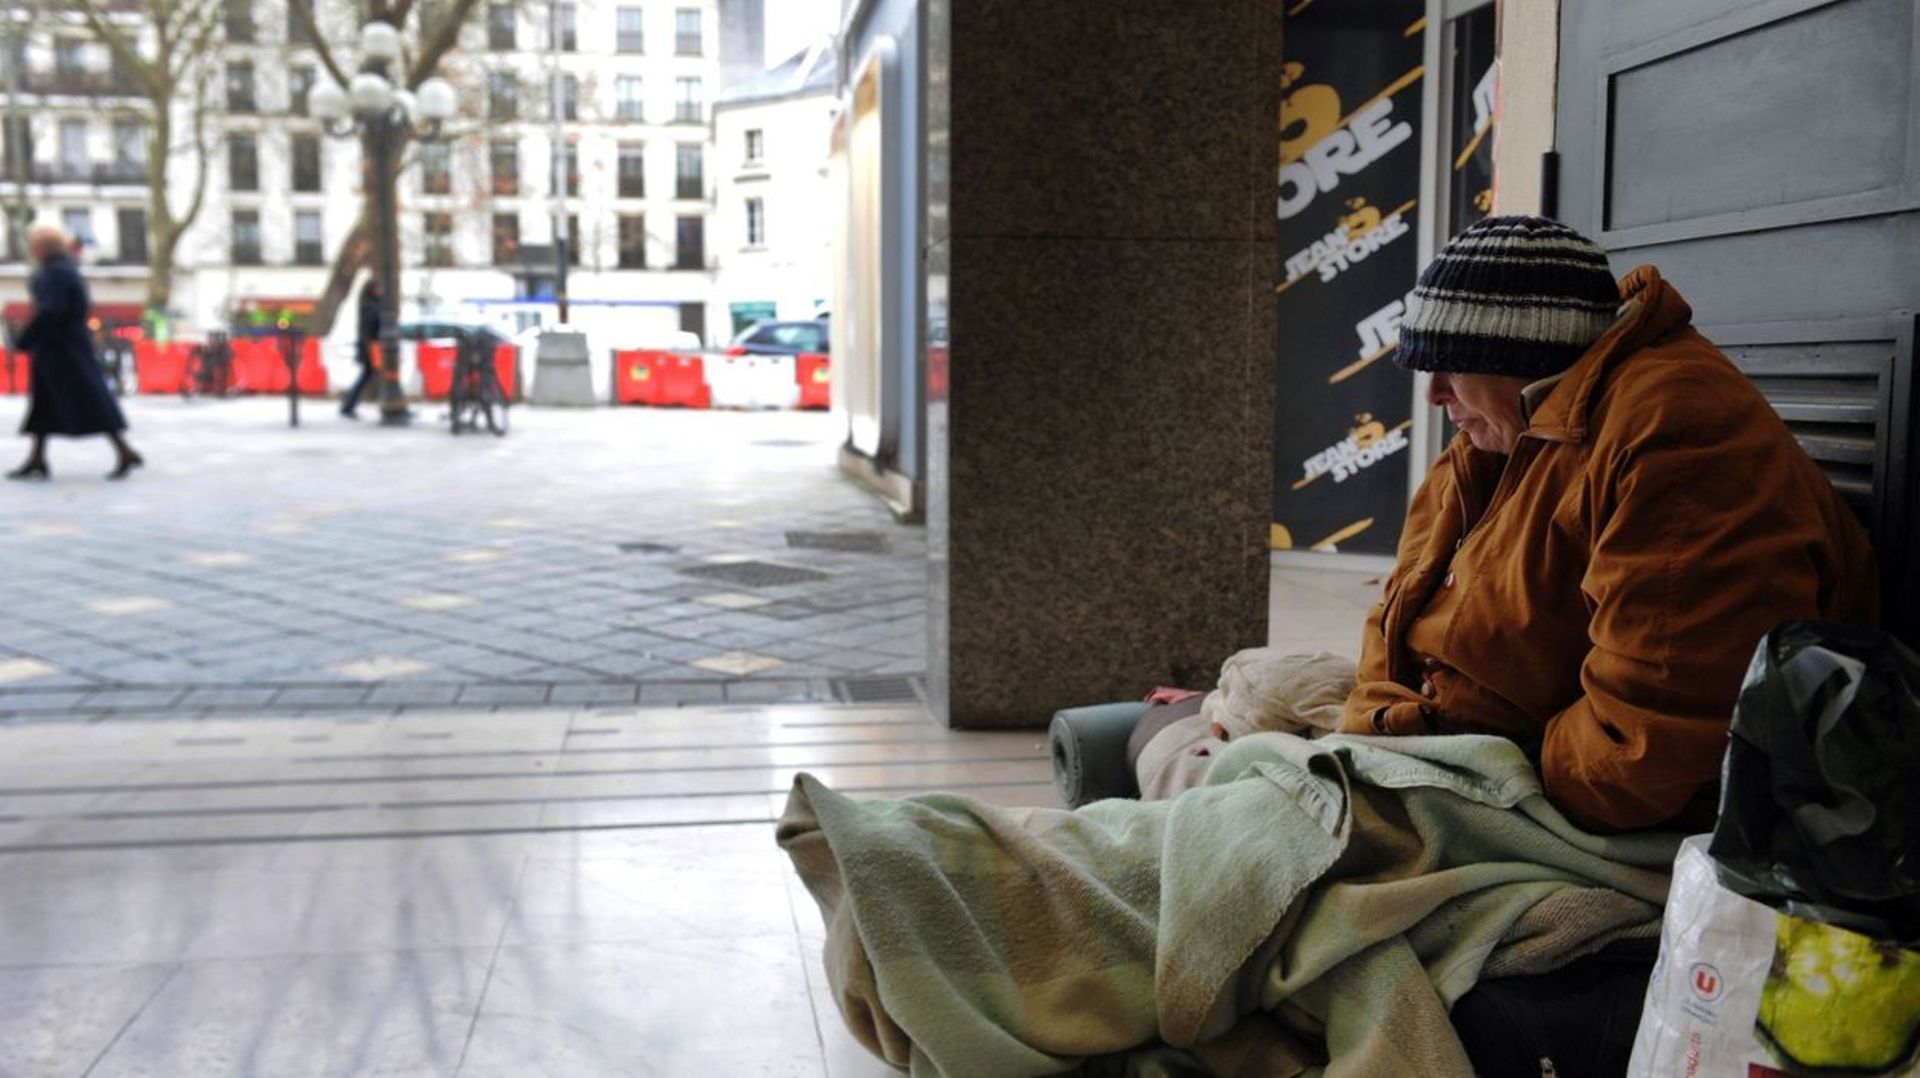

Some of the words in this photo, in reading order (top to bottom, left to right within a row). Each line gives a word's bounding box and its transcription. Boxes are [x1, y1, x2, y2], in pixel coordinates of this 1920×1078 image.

[1277, 96, 1413, 220] ORE
[1316, 212, 1410, 283] STORE
[1329, 428, 1409, 483] STORE
[1696, 970, 1716, 994] U
